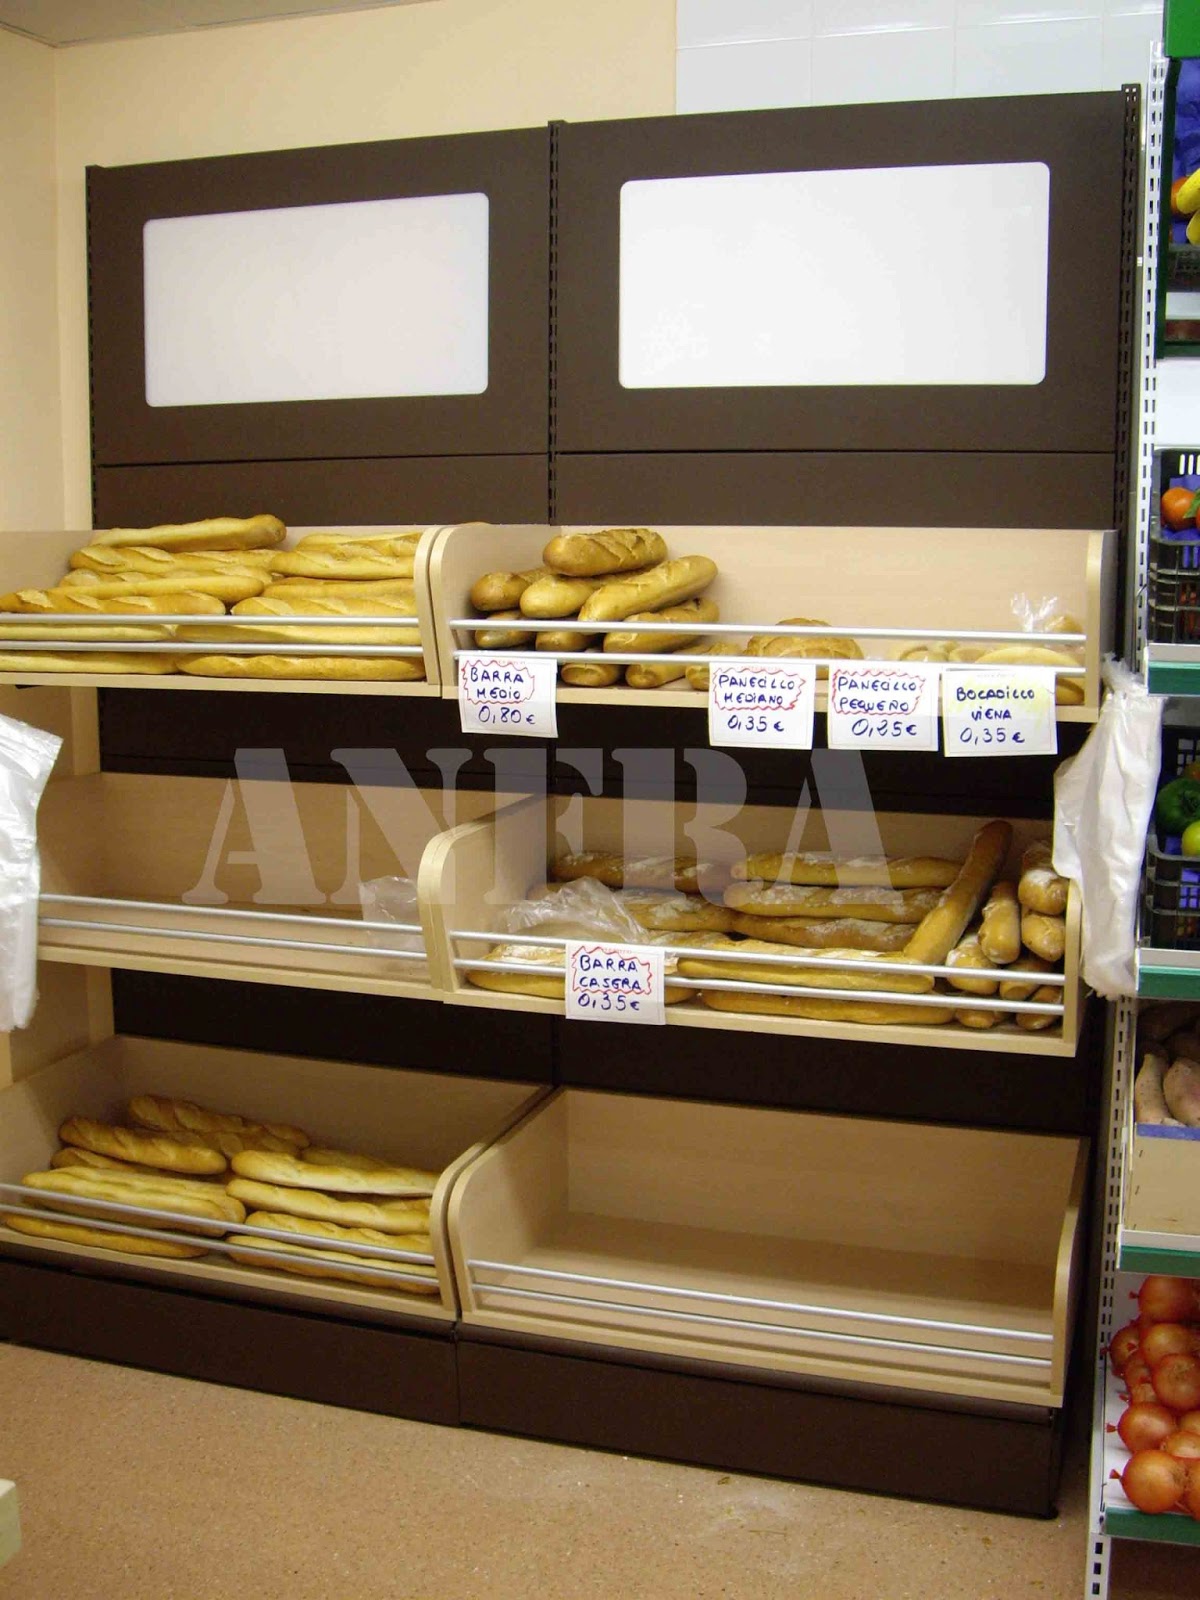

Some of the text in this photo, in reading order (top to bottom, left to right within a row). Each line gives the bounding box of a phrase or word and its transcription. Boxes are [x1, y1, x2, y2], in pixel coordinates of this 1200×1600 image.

[470, 666, 524, 682] BARRA
[718, 674, 795, 690] PANECILLO
[838, 676, 917, 692] PANECILLO
[476, 687, 521, 699] MEDIO
[723, 692, 784, 705] MEDIANO
[956, 686, 1035, 702] BOCADILLO
[971, 706, 1012, 721] VIENA
[580, 954, 638, 972] BARRA
[579, 976, 642, 991] CASERA
